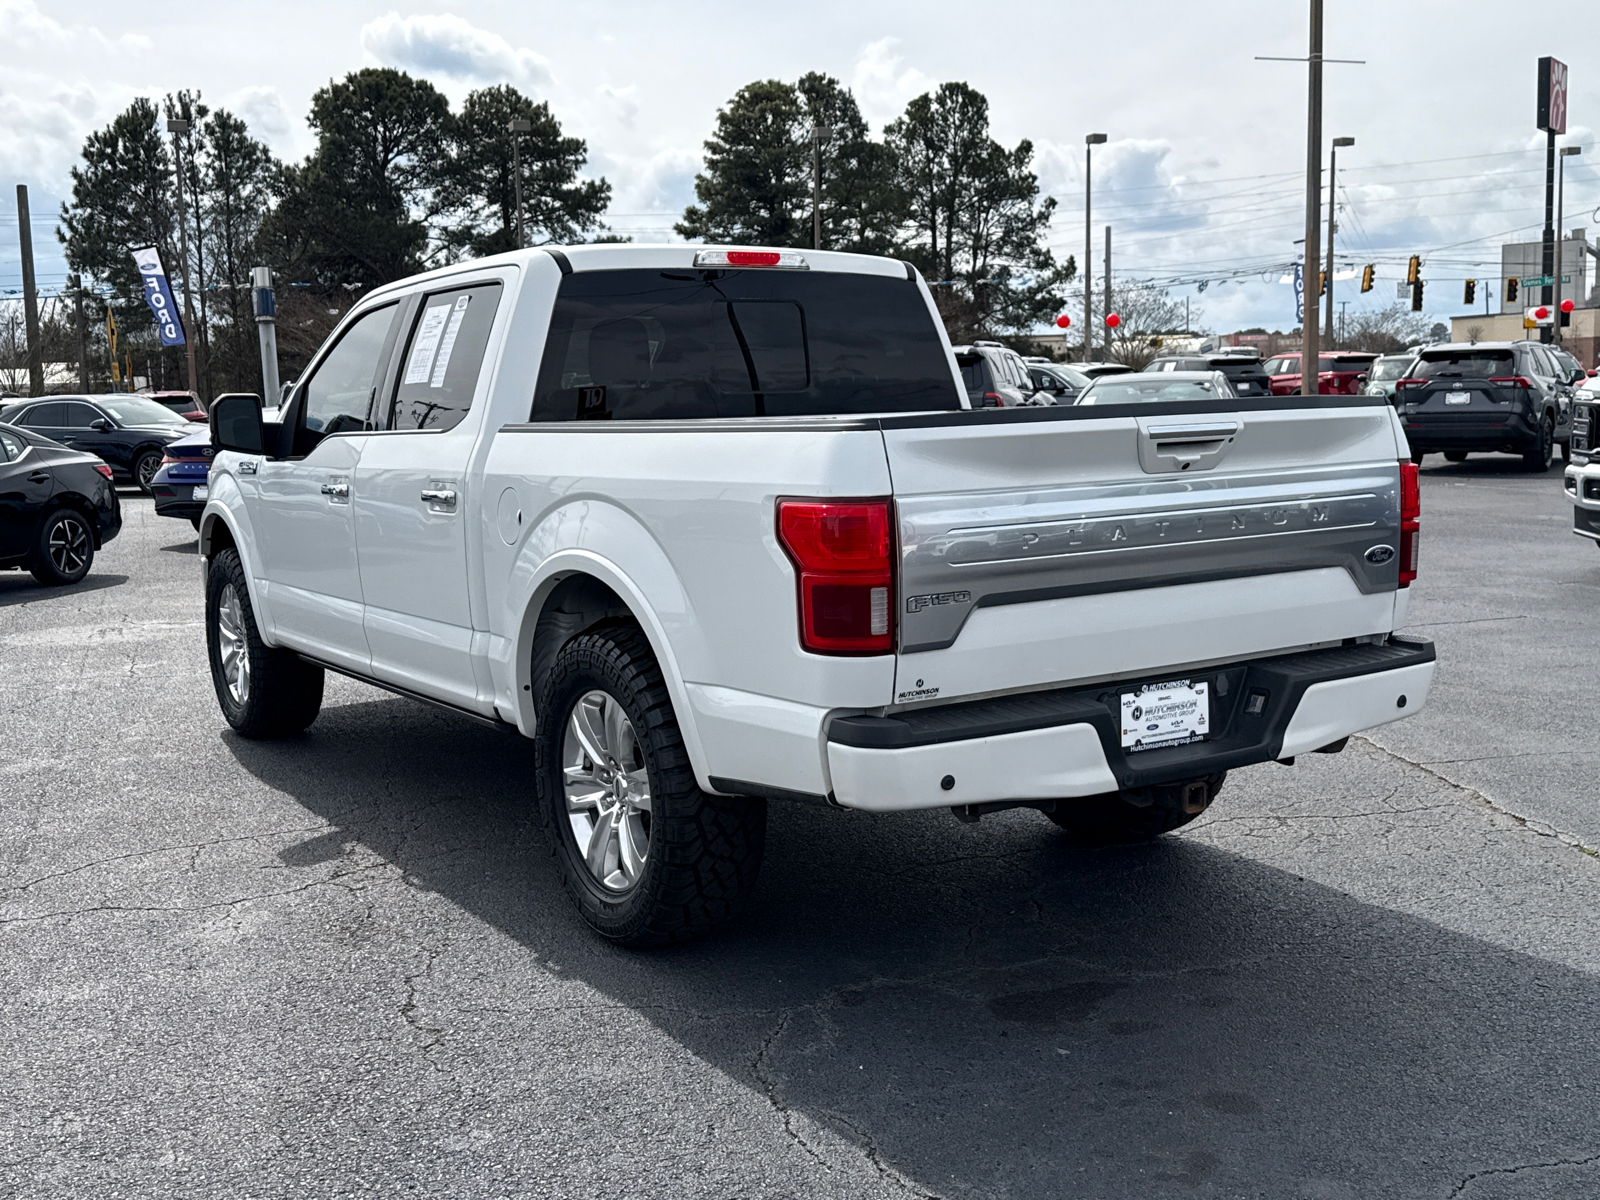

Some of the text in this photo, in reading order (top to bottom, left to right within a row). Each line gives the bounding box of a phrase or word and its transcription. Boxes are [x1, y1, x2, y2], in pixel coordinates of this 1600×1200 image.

[1022, 506, 1329, 549] PLATINUM
[1372, 548, 1390, 561] Ford
[1149, 679, 1191, 691] HUTCHINSON
[898, 687, 940, 698] HUTCHINSON
[1144, 701, 1197, 715] HUTCHINSON
[1145, 709, 1196, 722] AUTOMOTIVE GROUP
[1130, 735, 1204, 752] Hutchinsonautogroup.com
